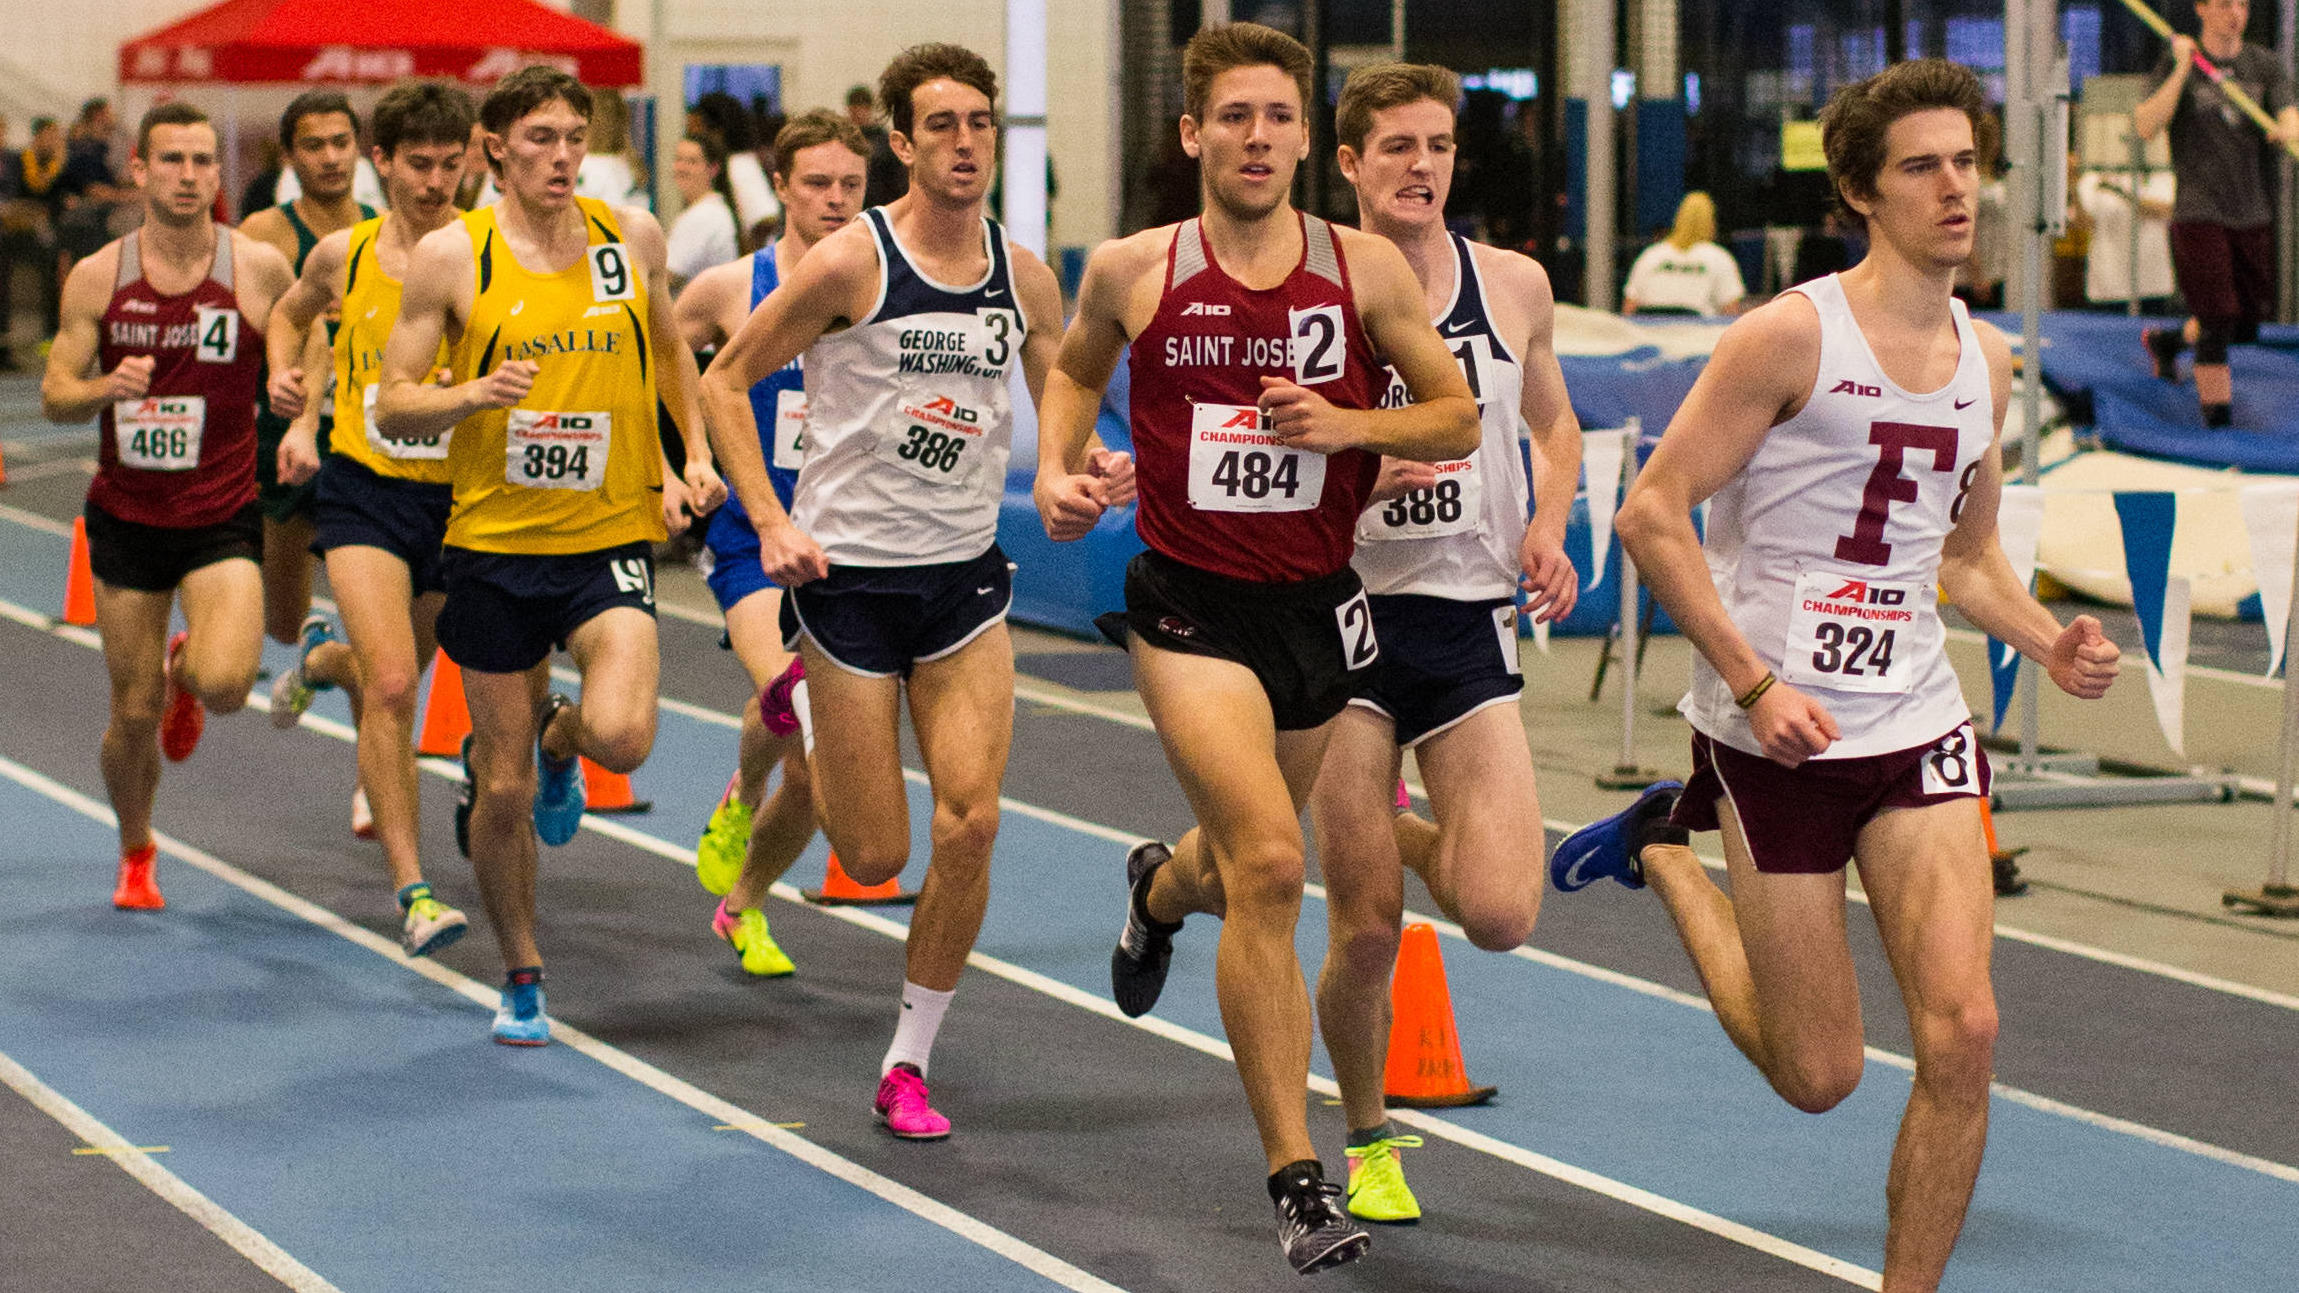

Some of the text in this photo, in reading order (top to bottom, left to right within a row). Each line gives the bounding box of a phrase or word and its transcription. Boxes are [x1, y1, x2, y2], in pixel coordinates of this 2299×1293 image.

[596, 247, 626, 295] 9
[1180, 302, 1232, 316] A10
[110, 321, 159, 347] SAINT
[203, 315, 229, 356] 4
[899, 329, 966, 351] GEORGE
[985, 313, 1009, 367] 3
[1165, 336, 1234, 367] SAINT
[1298, 313, 1336, 380] 2
[1453, 341, 1481, 398] 1
[1829, 380, 1881, 397] A10
[531, 414, 592, 429] A10
[923, 396, 978, 422] A10
[1221, 409, 1278, 430] A1
[131, 428, 187, 458] 466
[524, 444, 588, 480] 394
[897, 425, 966, 472] 386
[1212, 451, 1300, 498] 484
[1834, 421, 1959, 566] F
[1383, 479, 1461, 527] 388
[1802, 600, 1912, 622] CHAMPIONSHIPS
[1826, 579, 1906, 605] A10
[1344, 599, 1376, 665] 2
[1812, 622, 1896, 677] 324
[1931, 731, 1968, 787] 8
